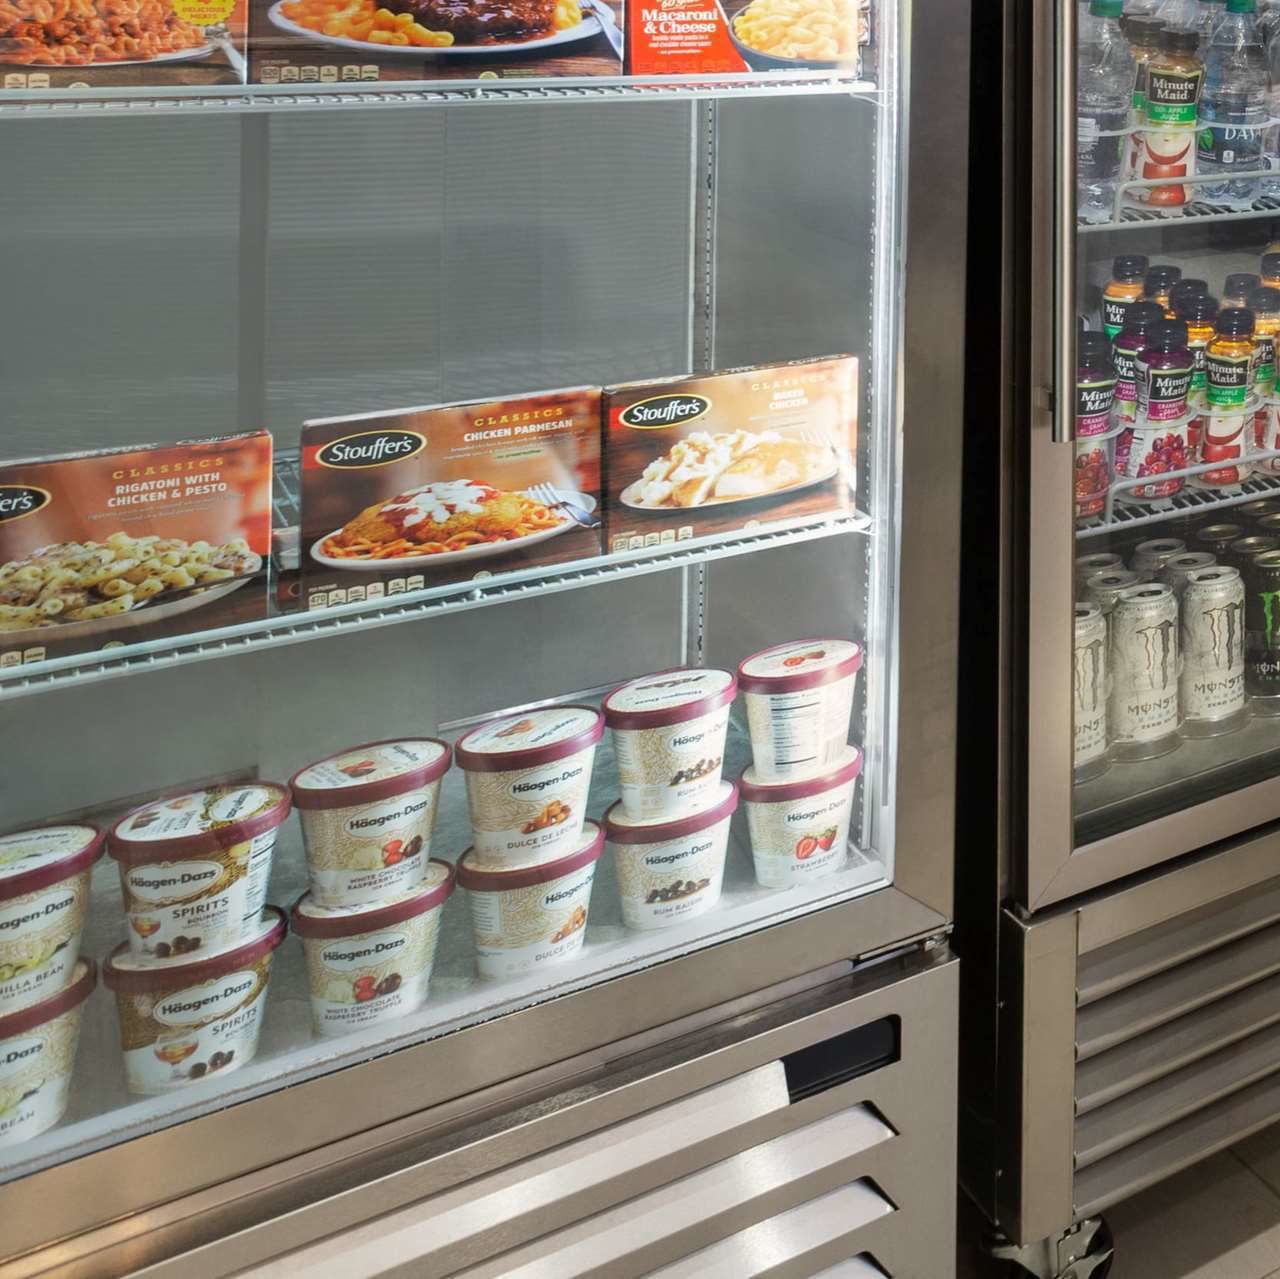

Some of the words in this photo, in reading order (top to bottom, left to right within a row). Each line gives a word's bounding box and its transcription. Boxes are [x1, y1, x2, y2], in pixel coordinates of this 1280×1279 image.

[642, 9, 718, 21] Macaroni
[644, 22, 656, 34] &
[659, 21, 716, 33] Cheese
[1153, 78, 1195, 90] Minute
[1157, 89, 1188, 100] Maid
[1207, 362, 1244, 374] Minute
[1210, 372, 1238, 384] Maid
[474, 407, 564, 427] CLASSICS
[631, 400, 700, 423] Stouffer's
[463, 428, 512, 442] CHICKEN
[514, 419, 573, 435] PARMESAN
[329, 436, 413, 463] Stouffer's
[112, 457, 225, 480] CLASSICS
[115, 477, 181, 495] RIGATONI
[185, 472, 220, 486] WITH
[107, 490, 166, 508] CHICKEN
[171, 487, 181, 499] &
[185, 482, 228, 497] PESTO
[507, 836, 538, 850] DULCE
[172, 896, 229, 920] SPIRITS
[653, 901, 676, 916] RUM
[535, 945, 563, 962] DULCE
[36, 964, 64, 984] BEAN
[212, 1006, 258, 1037] SPIRITS
